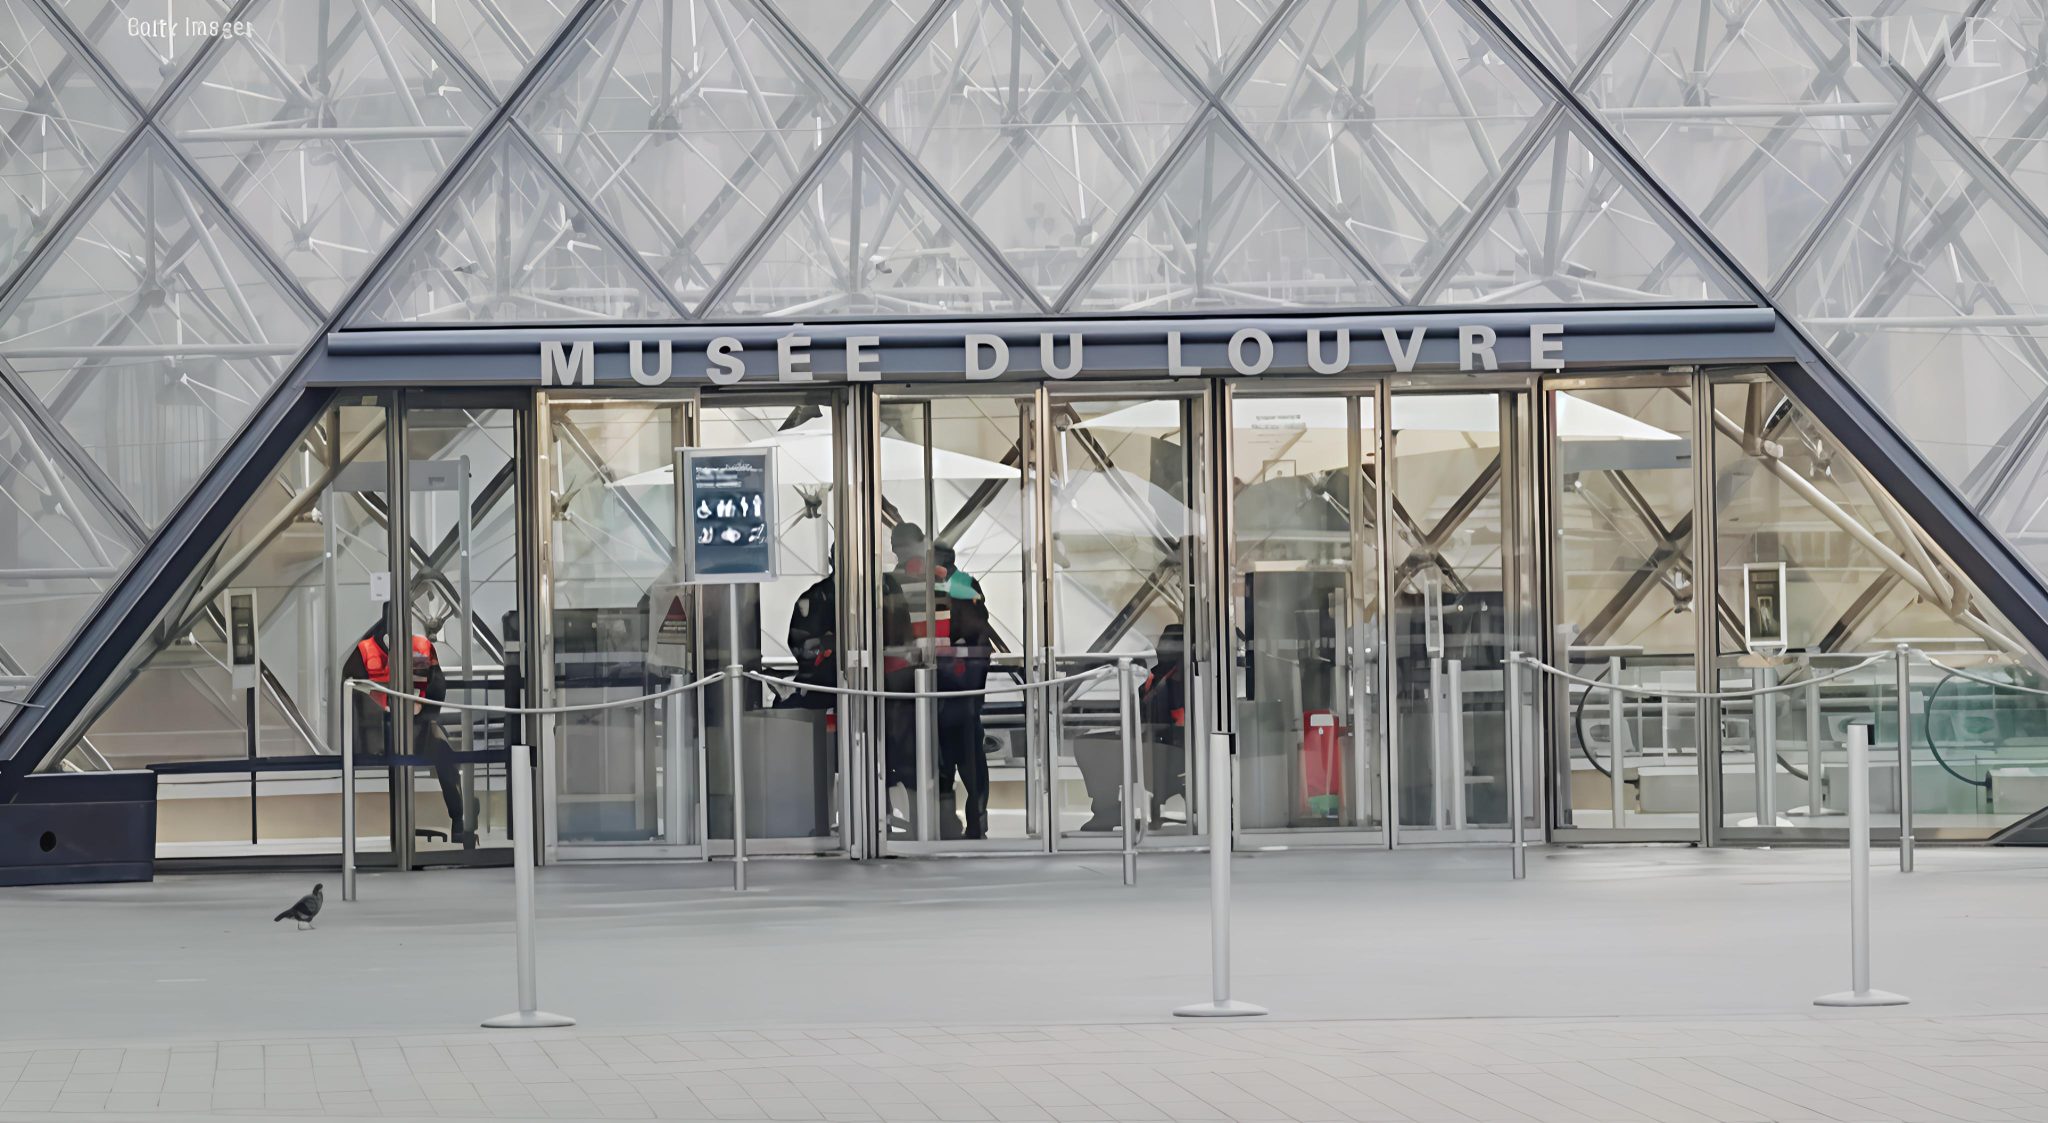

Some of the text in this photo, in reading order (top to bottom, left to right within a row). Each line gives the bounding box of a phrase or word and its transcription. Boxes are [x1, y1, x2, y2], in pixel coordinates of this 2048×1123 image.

[540, 323, 1565, 386] MUSÉE DU LOUVRE
